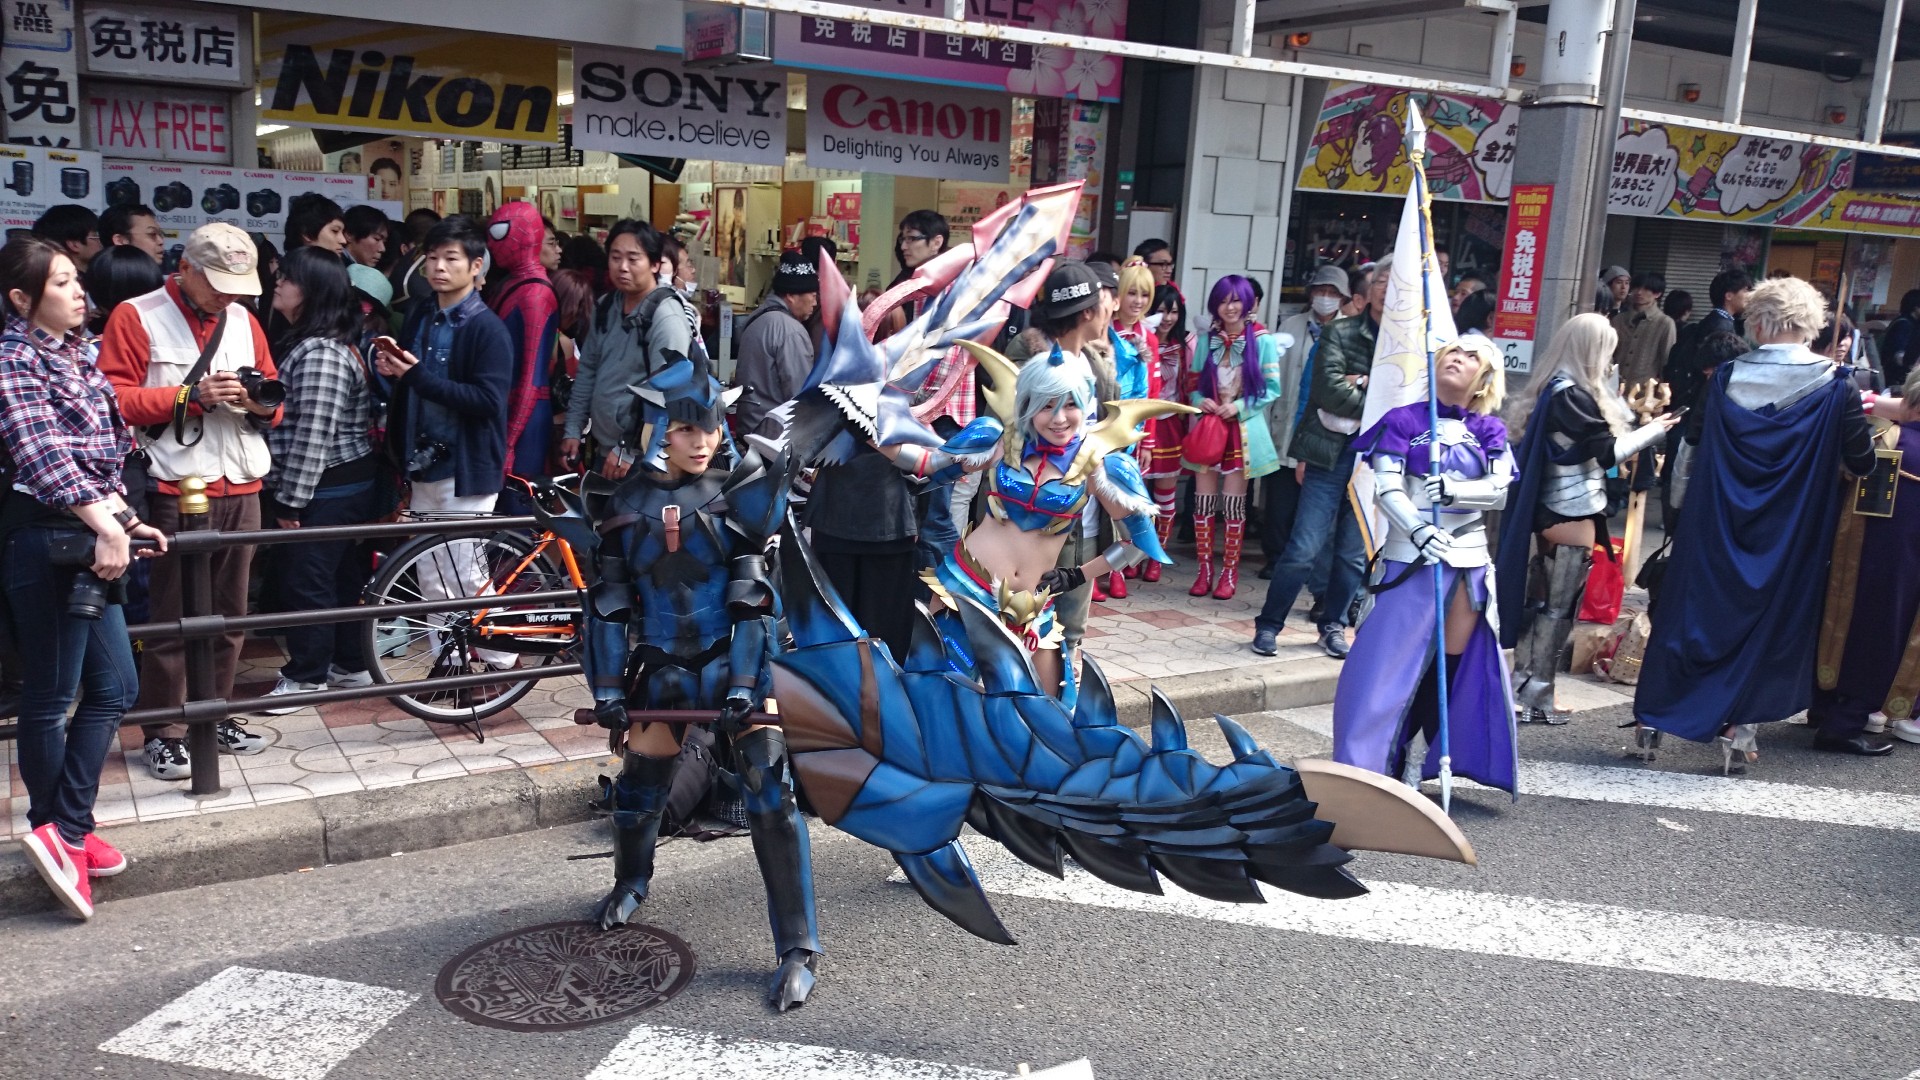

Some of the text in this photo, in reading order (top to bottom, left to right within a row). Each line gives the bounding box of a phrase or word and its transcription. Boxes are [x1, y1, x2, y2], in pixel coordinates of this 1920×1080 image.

[15, 2, 49, 18] TAX
[13, 16, 54, 34] FREE
[89, 17, 236, 68] 免税店
[271, 43, 557, 133] Nikon
[580, 61, 781, 119] SONY
[5, 60, 76, 148] 免
[822, 83, 1000, 144] Canon
[90, 98, 226, 154] TAX FREE
[585, 111, 771, 151] make.believe
[823, 134, 999, 169] Delighting You Always
[1744, 138, 1793, 161] ホビーの
[149, 165, 182, 173] Canon
[200, 168, 232, 176] Canon
[243, 171, 275, 179] Canon
[284, 174, 315, 182] Canon
[324, 177, 354, 185] Canon
[1611, 175, 1655, 192] ルまるごと
[1518, 205, 1541, 217] LAND
[1507, 229, 1537, 300] 免税店
[1502, 328, 1527, 338] Joshin
[550, 613, 572, 622] SPIDER
